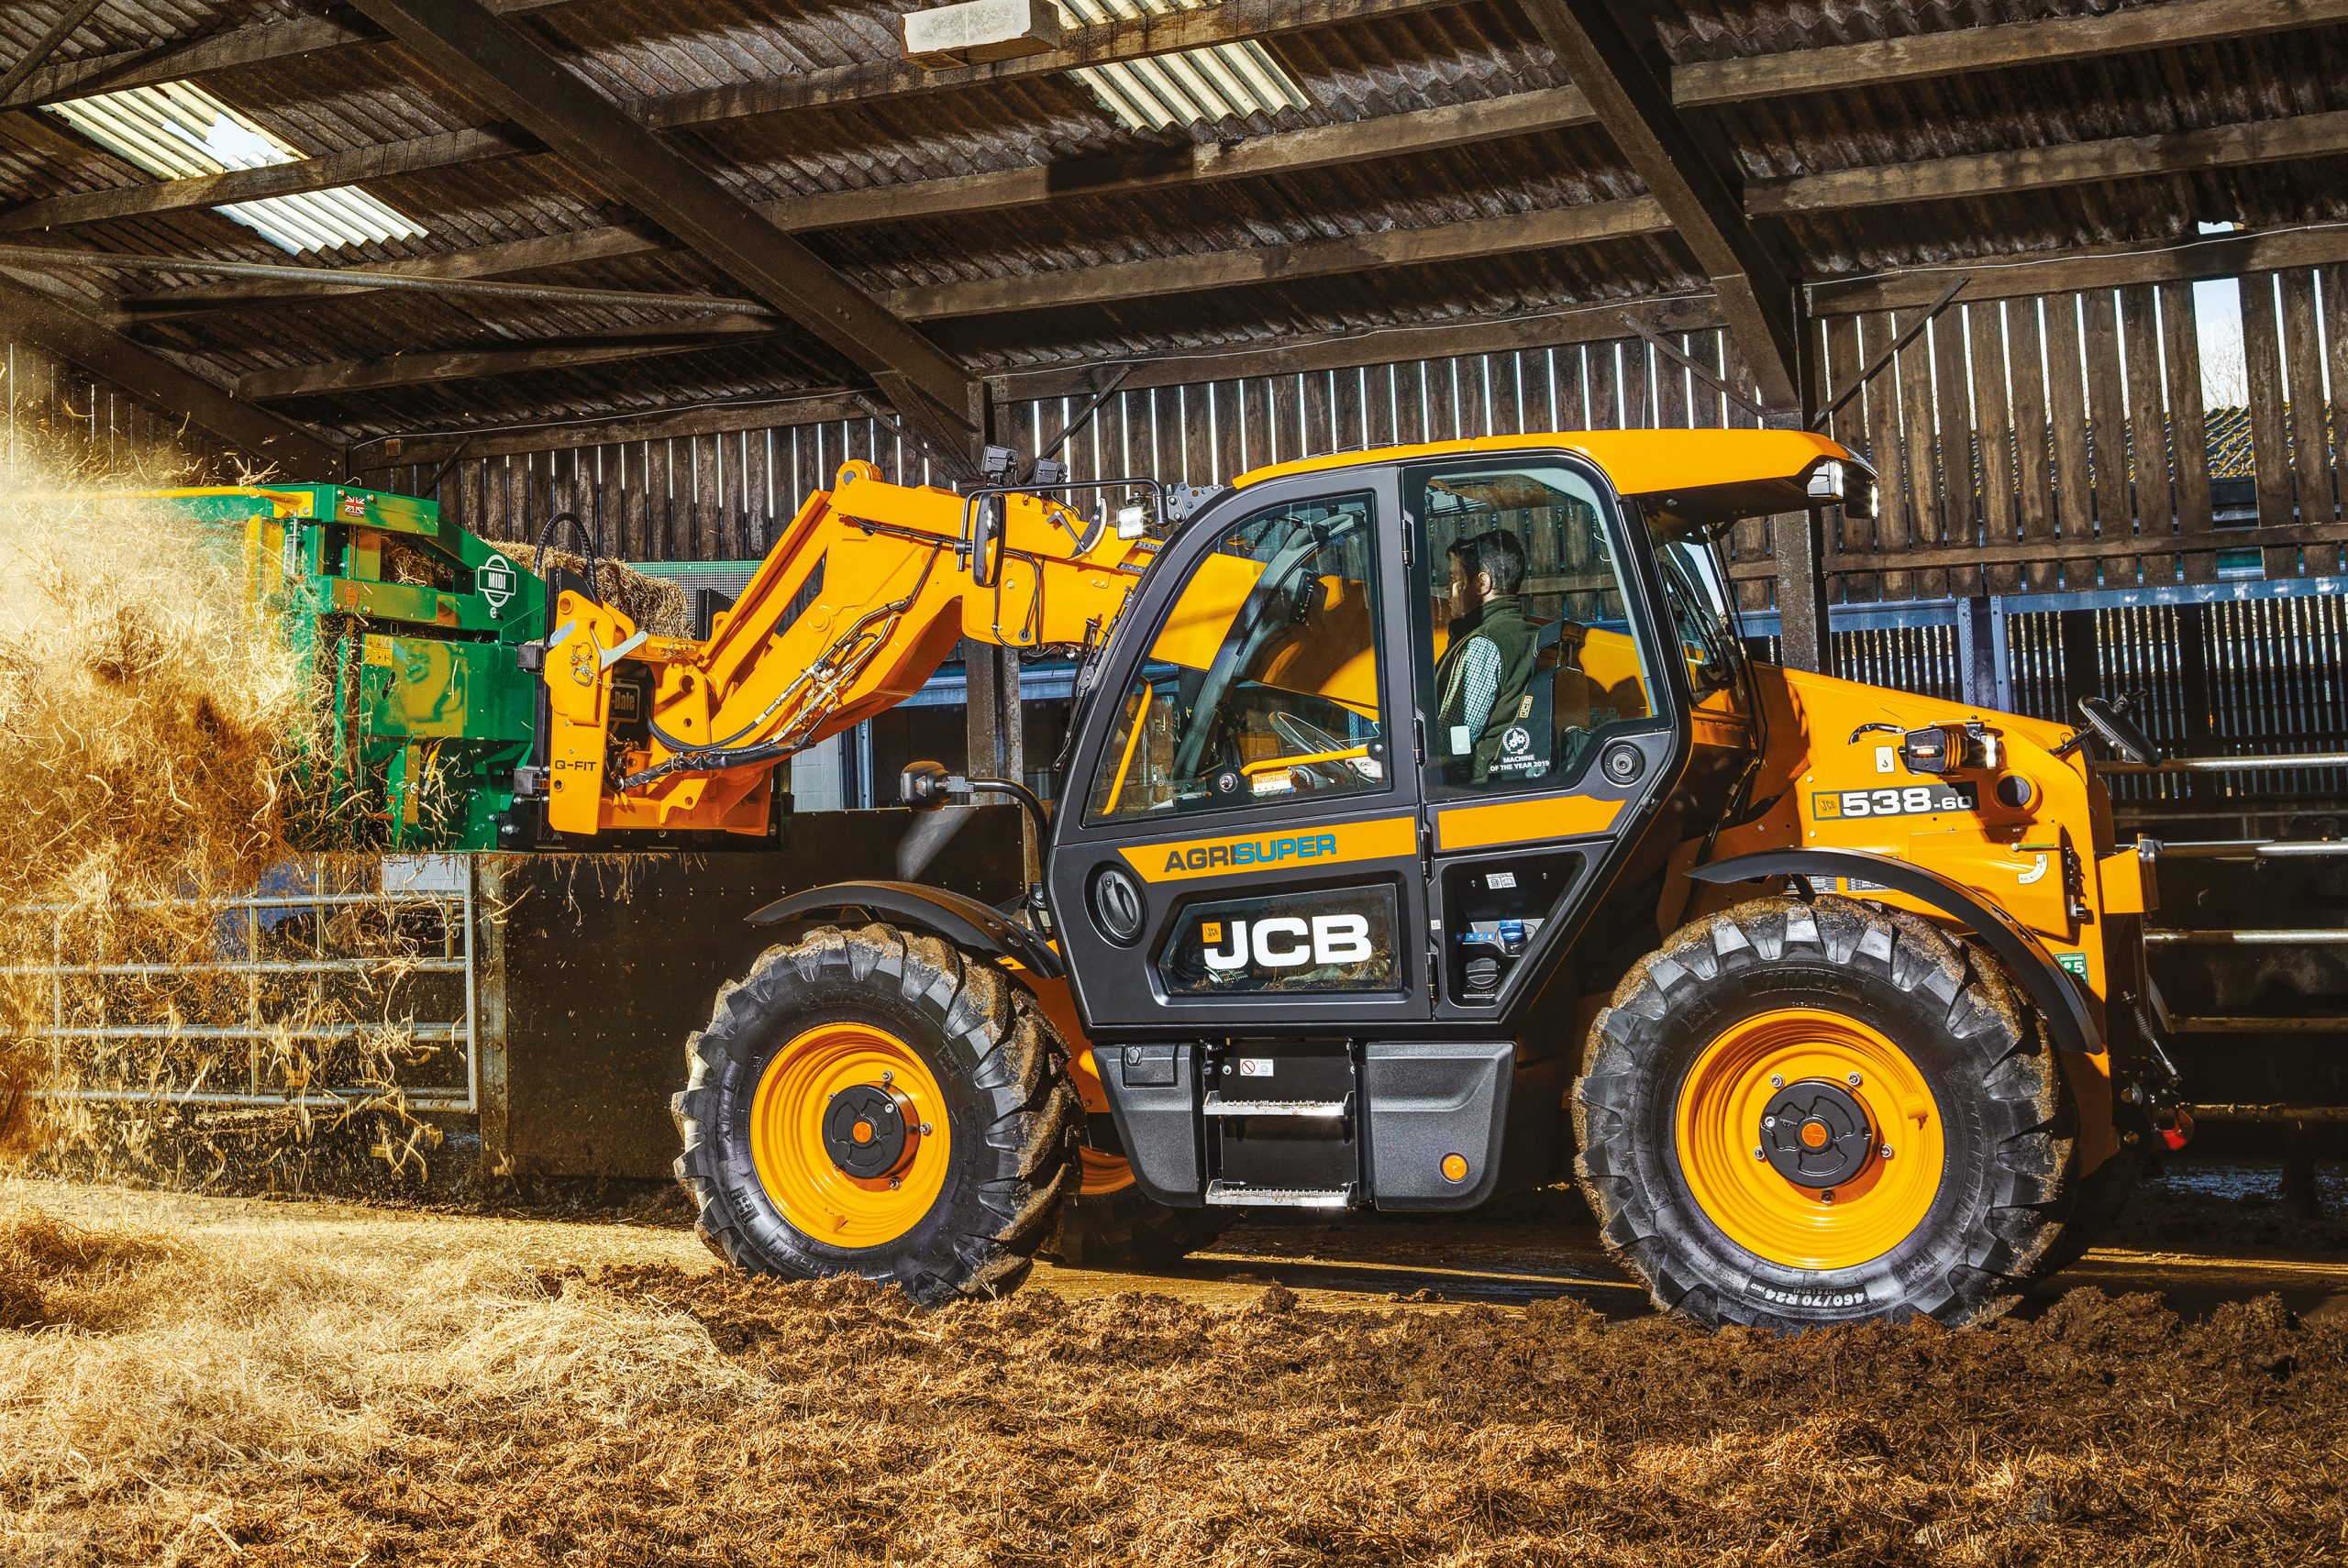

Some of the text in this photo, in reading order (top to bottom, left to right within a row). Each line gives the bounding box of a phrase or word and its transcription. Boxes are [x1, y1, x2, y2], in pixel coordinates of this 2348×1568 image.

[488, 571, 506, 590] MIDI
[554, 760, 597, 771] Q-FIT
[1502, 754, 1535, 763] MACHINE
[1513, 761, 1533, 769] YEAR
[1254, 773, 1289, 783] Thatcham
[1842, 787, 1973, 817] 538-60
[1163, 834, 1337, 873] AGRISUPER
[1202, 913, 1373, 970] JCB
[1750, 1283, 1865, 1307] 460/70 R24 IND
